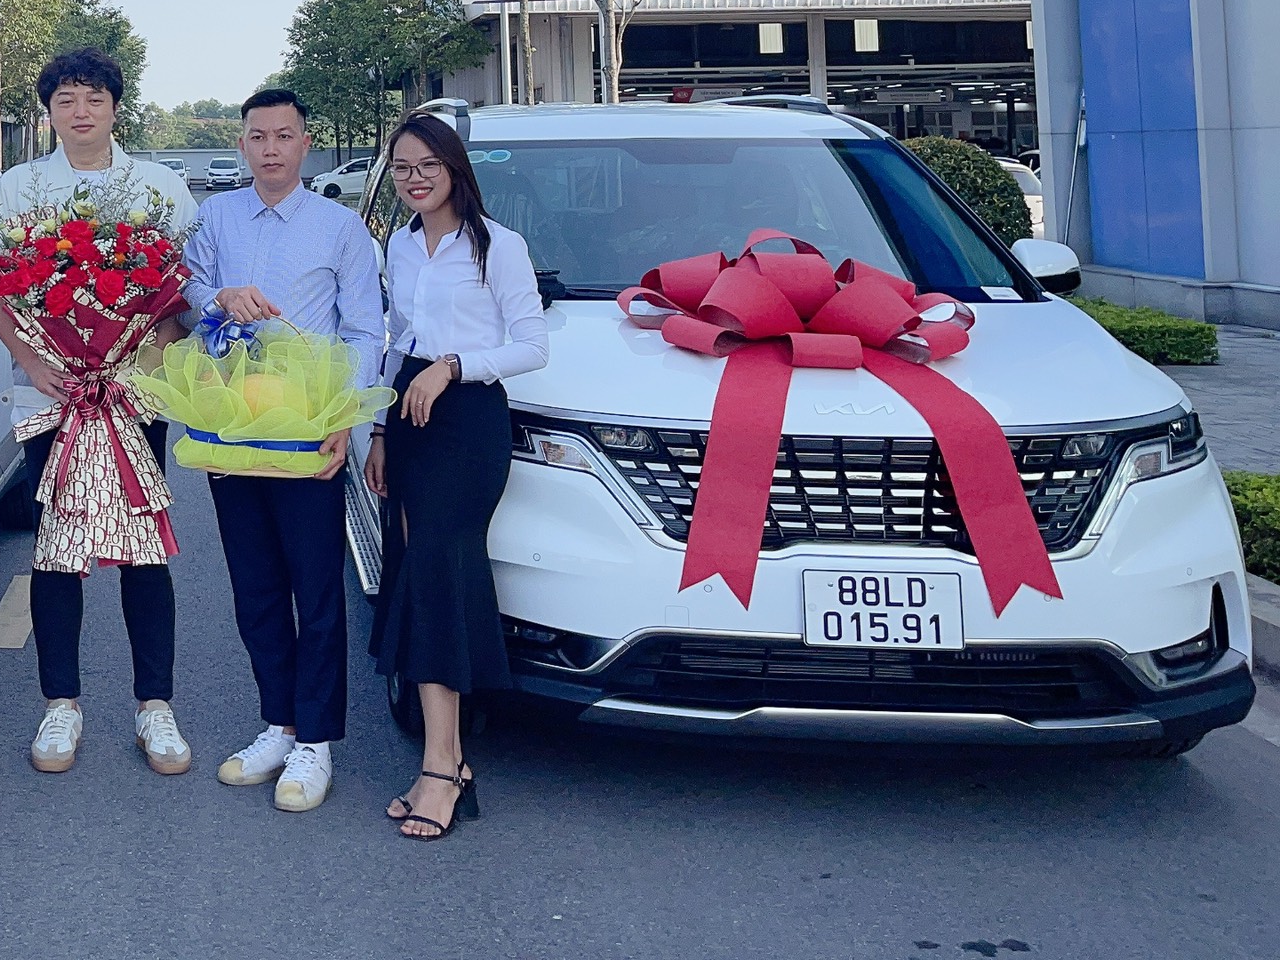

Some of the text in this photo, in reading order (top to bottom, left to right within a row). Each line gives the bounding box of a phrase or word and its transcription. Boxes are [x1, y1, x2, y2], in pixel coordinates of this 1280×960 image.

[813, 401, 897, 415] KIA
[837, 575, 927, 608] 88LD
[823, 611, 941, 645] 015.91
